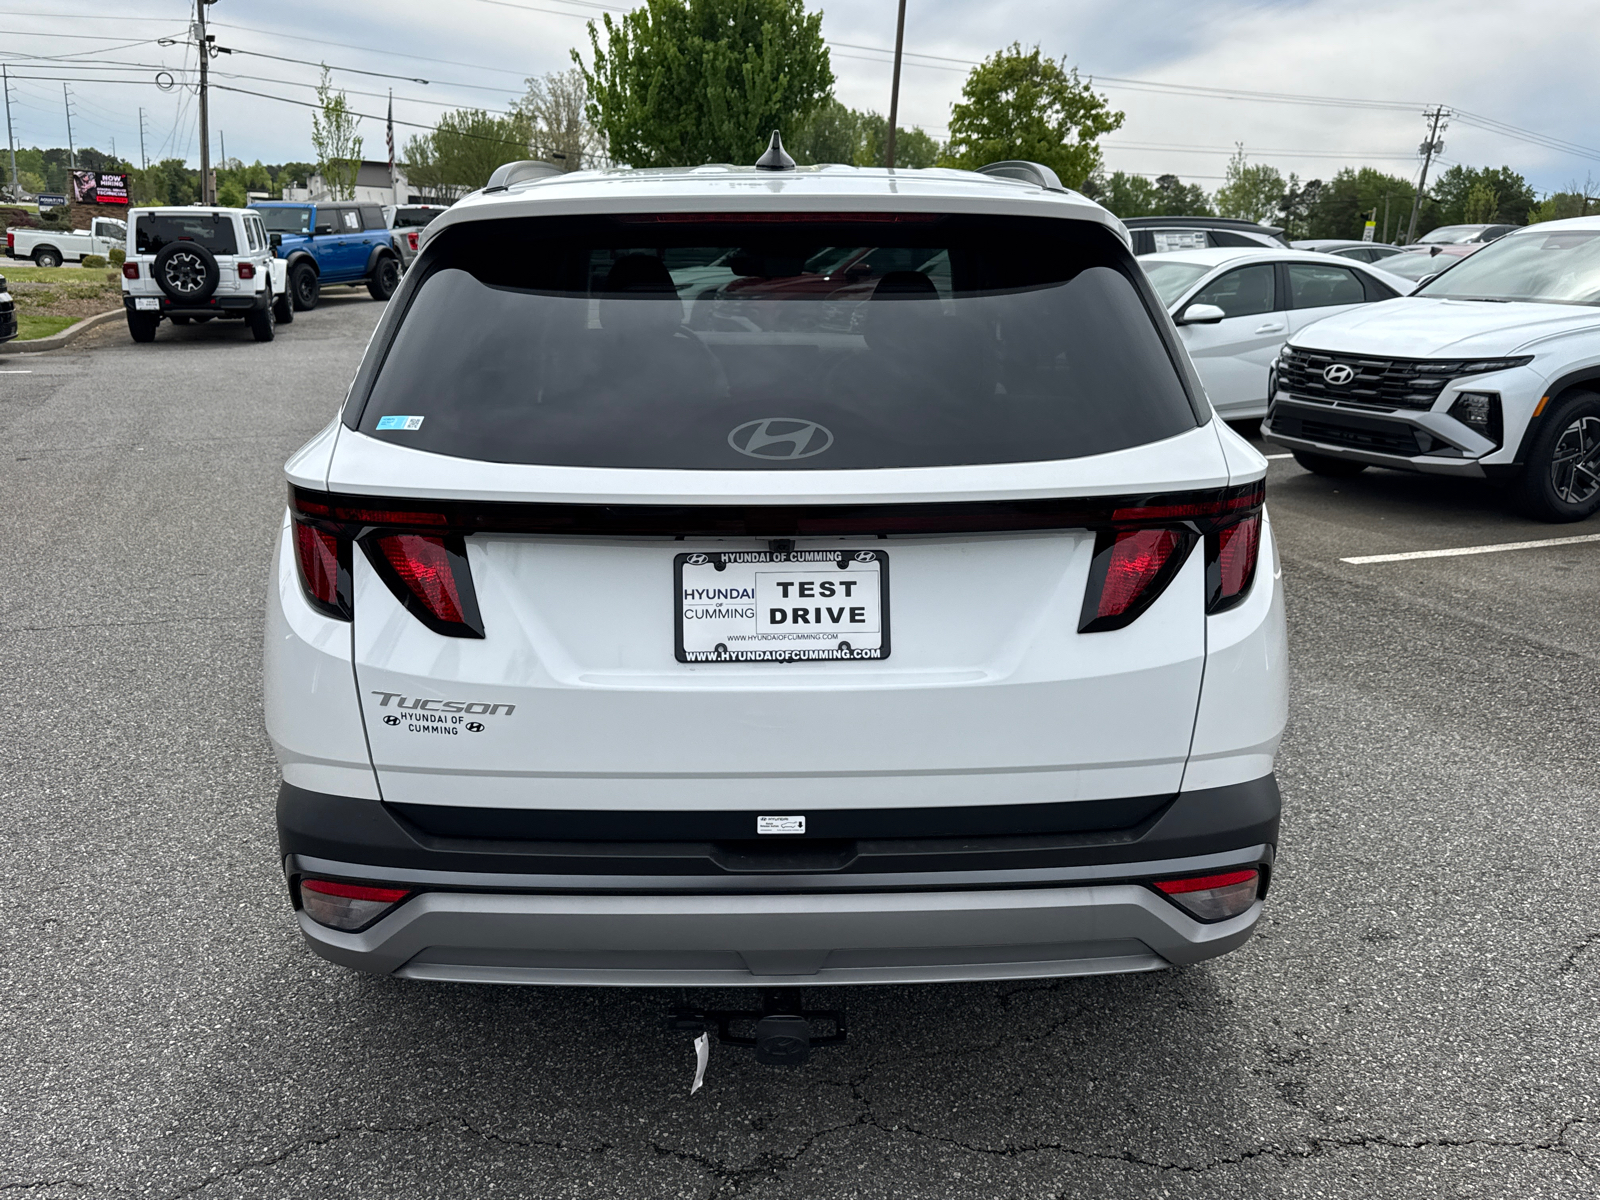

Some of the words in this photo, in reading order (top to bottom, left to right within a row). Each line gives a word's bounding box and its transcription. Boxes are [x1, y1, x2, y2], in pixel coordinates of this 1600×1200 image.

[721, 553, 770, 563] HYUNDAI
[773, 553, 787, 562] OF
[790, 552, 842, 562] CUMMING
[684, 588, 754, 600] HYUNDAI
[776, 581, 857, 598] TEST
[684, 608, 754, 620] CUMMING
[770, 606, 866, 624] DRIVE
[686, 649, 880, 661] WWW.HYUNDAIOFCUMMING.COM
[400, 712, 448, 724] HYUNDAI
[451, 716, 464, 724] OF
[408, 724, 458, 735] CUMMING
